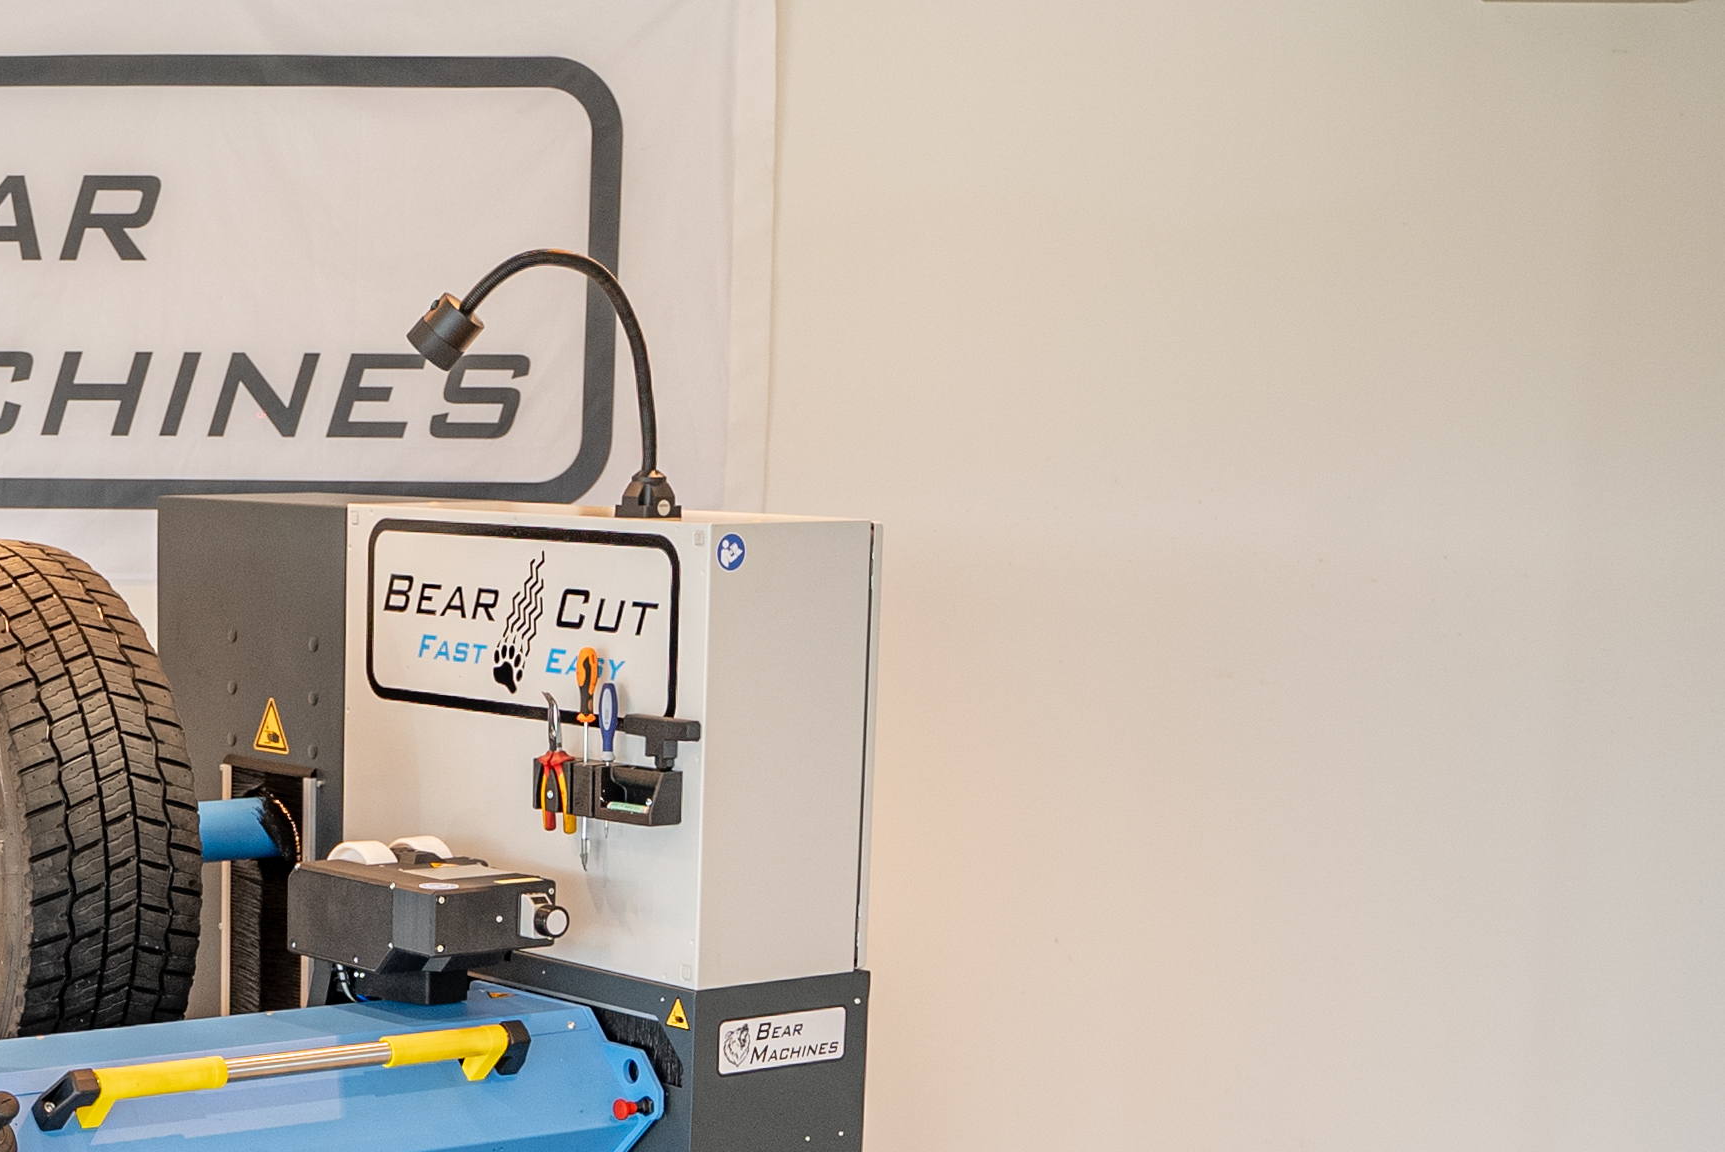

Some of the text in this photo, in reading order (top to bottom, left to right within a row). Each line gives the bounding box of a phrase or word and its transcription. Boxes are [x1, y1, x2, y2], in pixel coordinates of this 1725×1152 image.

[383, 574, 659, 636] BEAR CUT
[418, 634, 487, 664] FAST
[756, 1022, 804, 1041] BEAR
[749, 1041, 839, 1064] MACHINES
